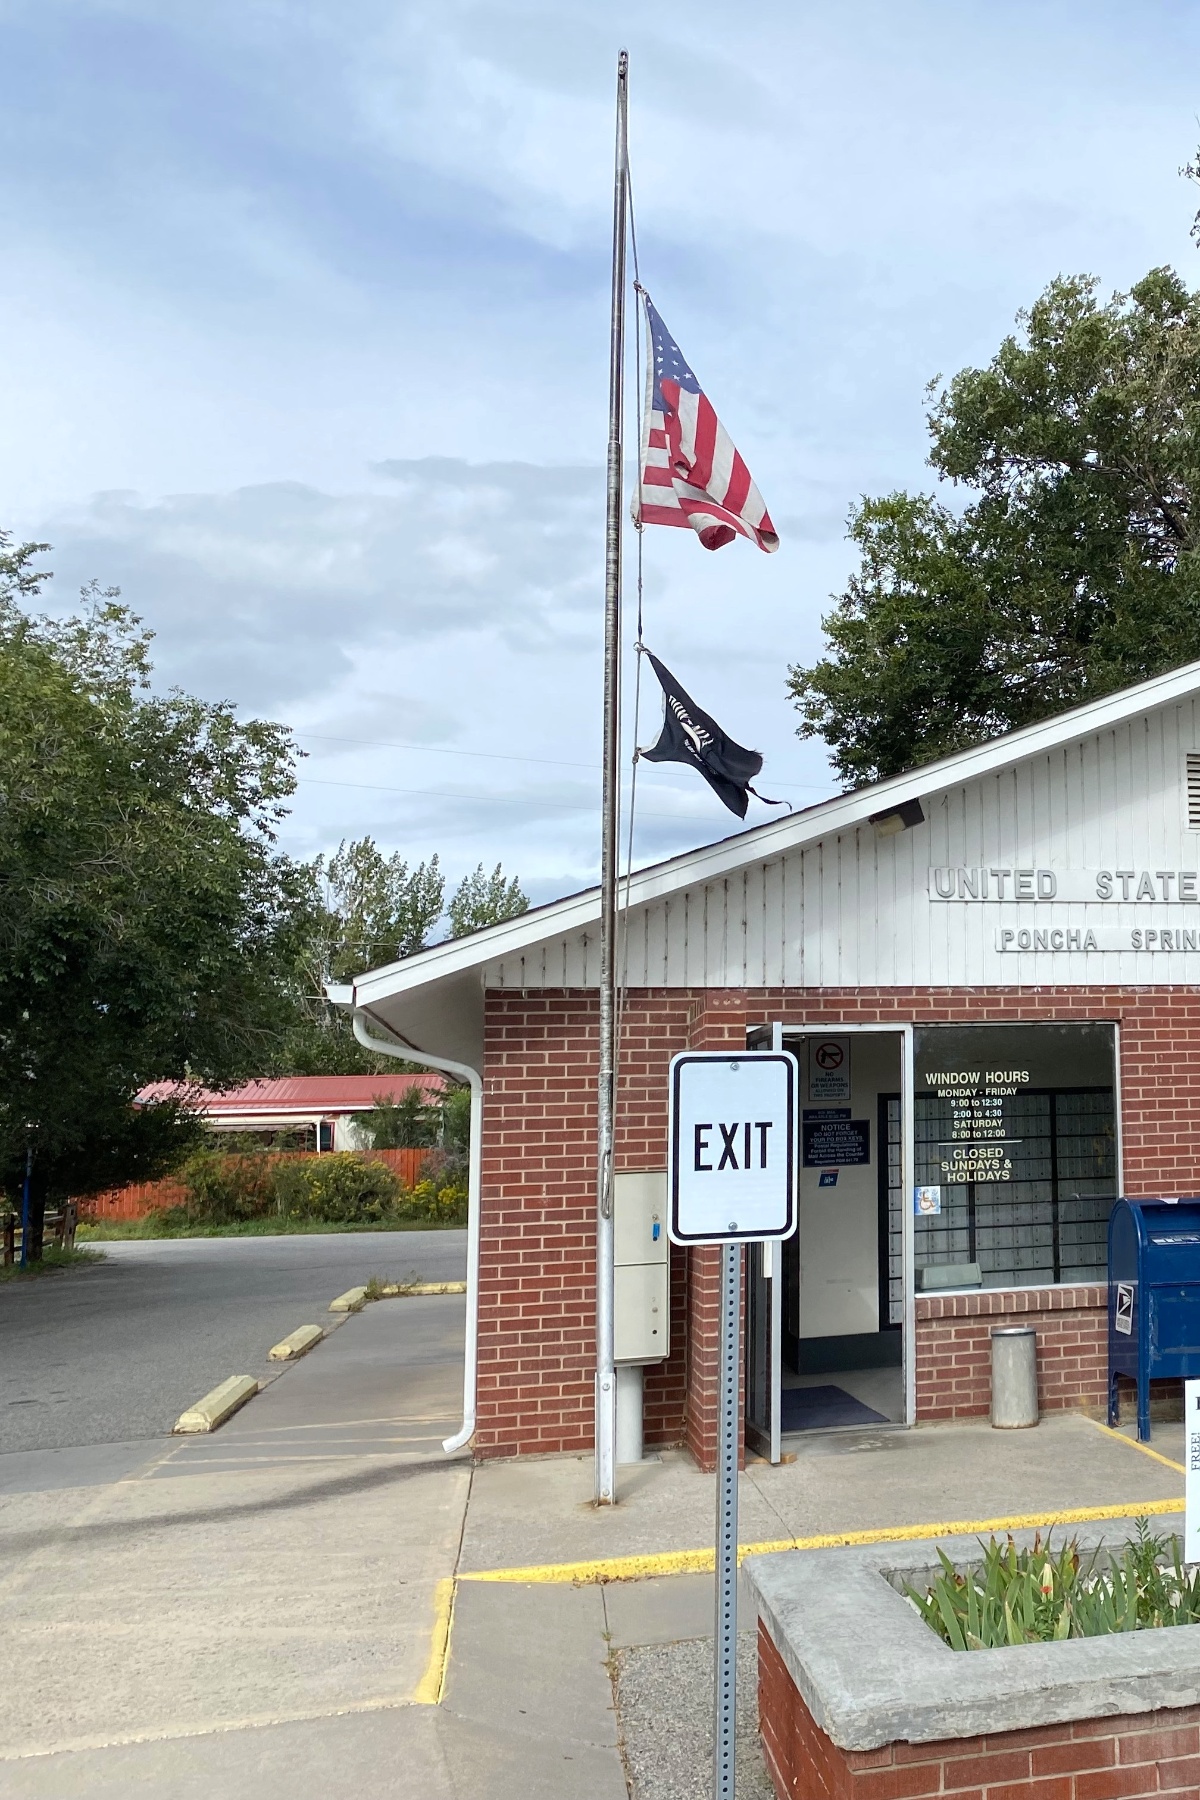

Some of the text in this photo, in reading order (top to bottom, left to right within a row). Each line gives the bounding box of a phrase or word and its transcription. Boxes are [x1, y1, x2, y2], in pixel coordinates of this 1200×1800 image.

[934, 868, 1058, 899] UNITED
[1000, 929, 1098, 950] PONCHA
[925, 1071, 1030, 1085] WINDOW HOURS
[937, 1088, 978, 1098] MONDAY
[985, 1087, 1018, 1096] FRIDAY
[950, 1098, 1003, 1107] 9:00 to 12:30
[953, 1109, 1002, 1119] 2:00 to 4:30
[821, 1123, 851, 1132] NOTICE
[953, 1119, 1003, 1129] SATURDAY
[951, 1129, 1006, 1139] 8:00 to 12:00
[694, 1121, 773, 1172] EXIT
[953, 1148, 1004, 1159] CLOSED
[941, 1159, 1012, 1171] SUNDAYS &
[947, 1170, 1010, 1183] HOLIDAYS
[1191, 1432, 1200, 1471] FREE!
